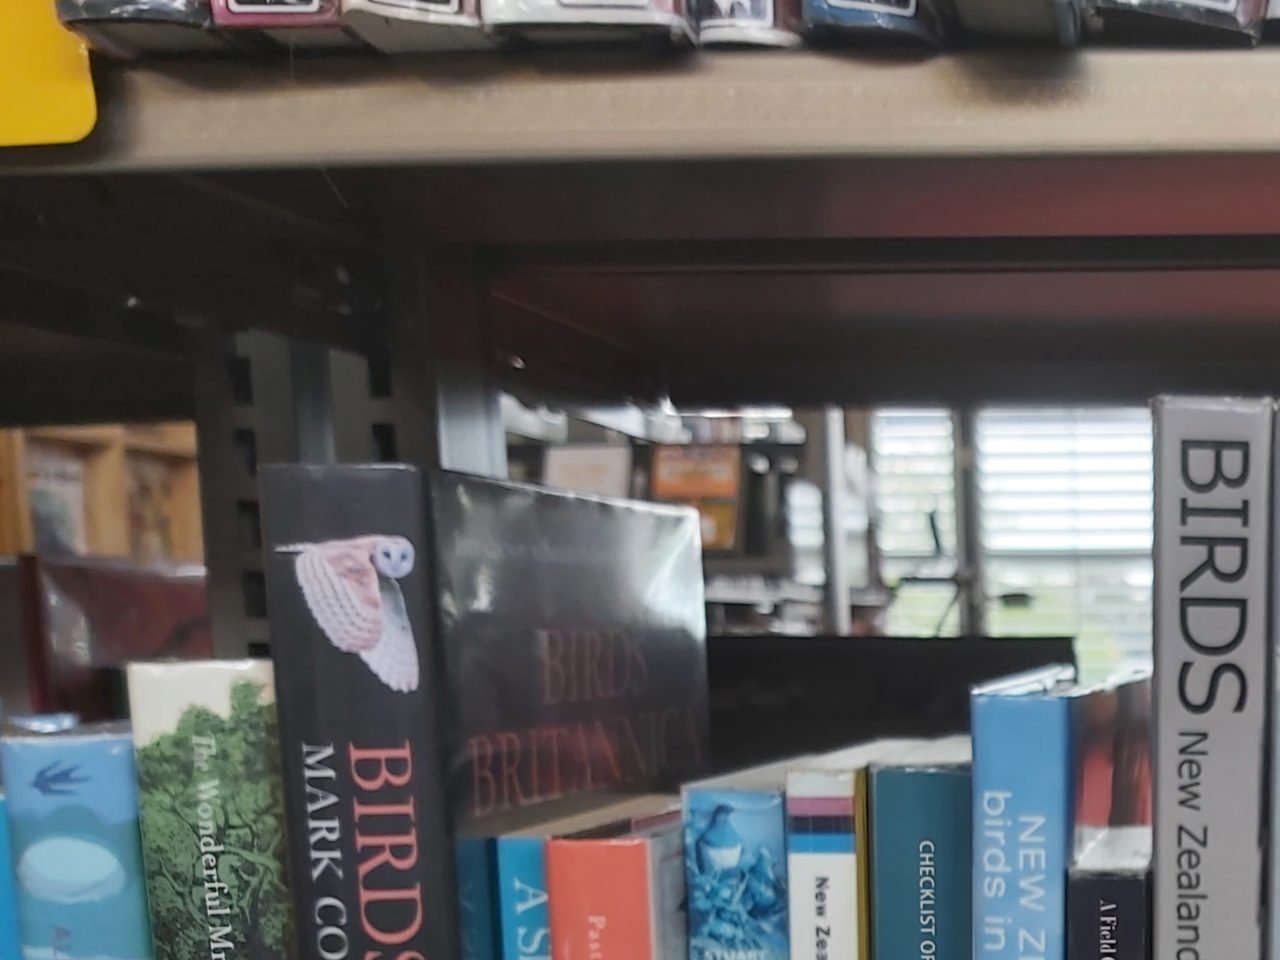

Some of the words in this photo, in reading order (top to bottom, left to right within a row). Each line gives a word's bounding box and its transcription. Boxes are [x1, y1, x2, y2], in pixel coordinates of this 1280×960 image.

[1178, 439, 1250, 715] BIRDS
[541, 629, 650, 704] BIRDS
[303, 742, 345, 880] MARK
[1177, 731, 1209, 811] New
[197, 778, 232, 916] Wonderful
[983, 791, 1012, 898] birds
[1017, 814, 1046, 913] NEW
[513, 877, 549, 915] A
[815, 876, 830, 917] New
[919, 840, 936, 936] CHECKLIST
[1099, 899, 1117, 913] A
[983, 918, 1012, 949] in
[1099, 916, 1117, 954] Field
